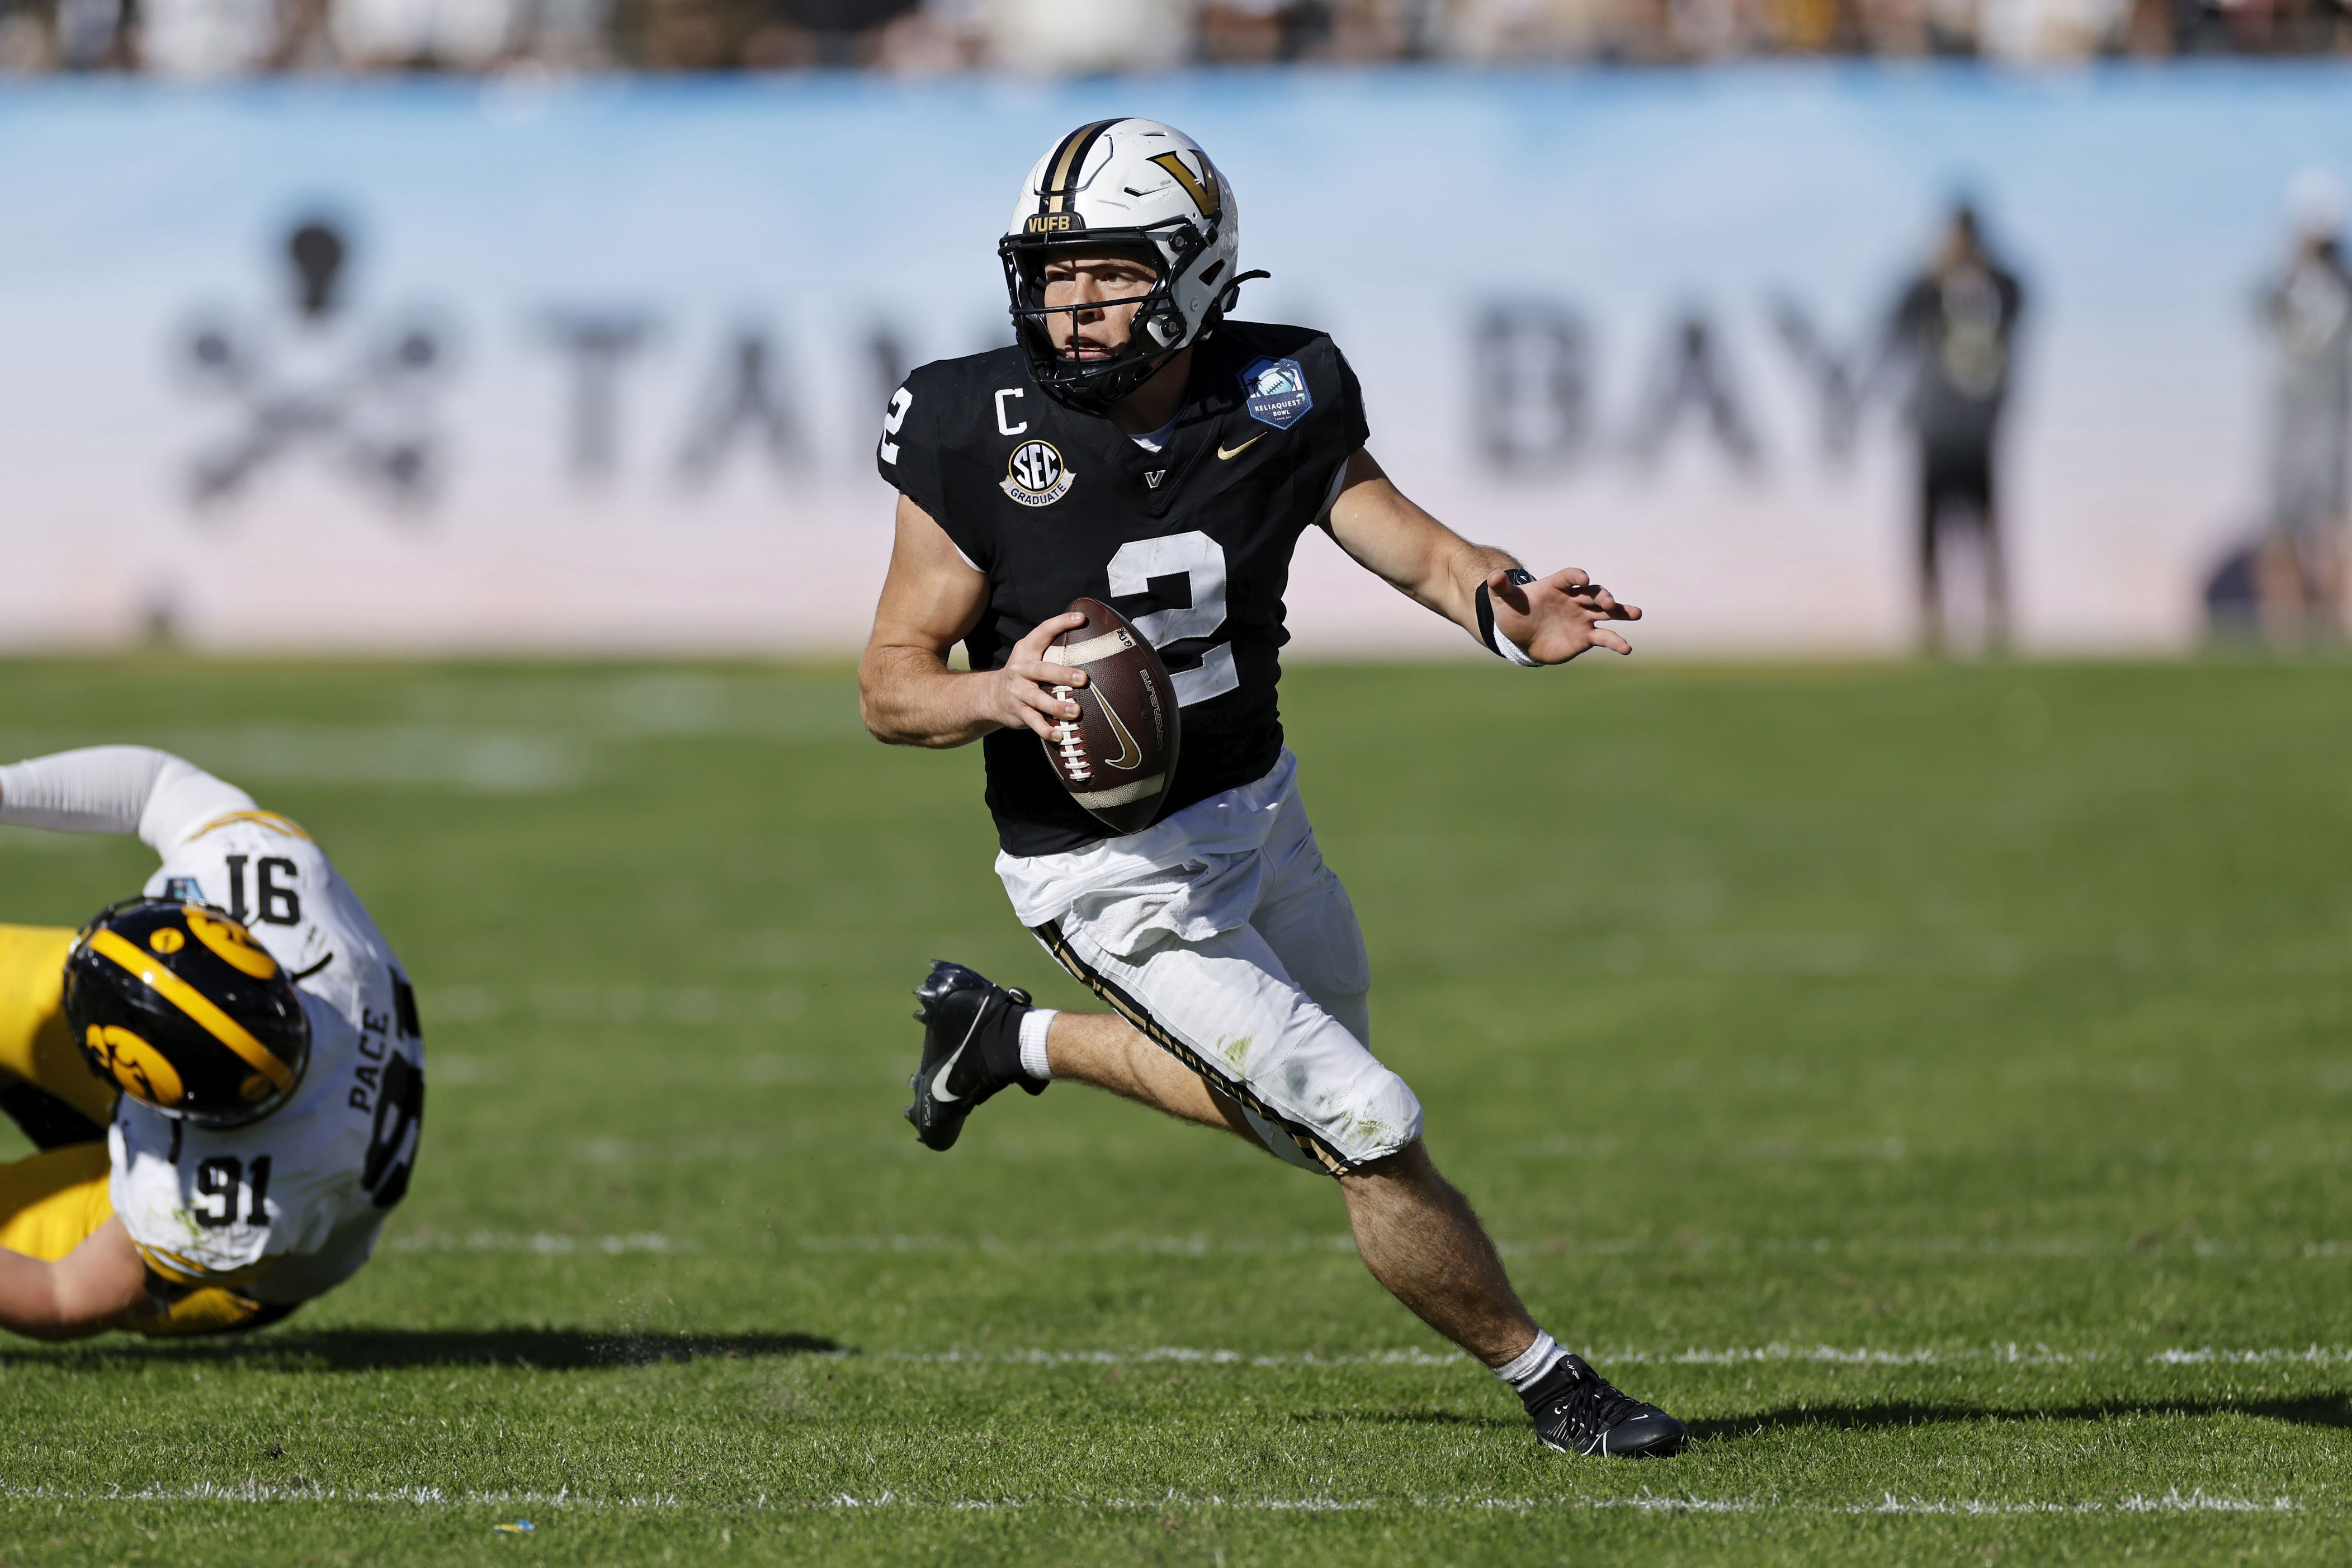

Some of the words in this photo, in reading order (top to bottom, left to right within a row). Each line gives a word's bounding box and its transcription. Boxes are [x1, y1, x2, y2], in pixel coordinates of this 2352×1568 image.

[1028, 216, 1070, 233] VUFB
[995, 388, 1027, 436] C
[1255, 399, 1301, 412] RELIAQUEST
[1473, 302, 1882, 478] BAY
[881, 387, 913, 465] 2
[1013, 444, 1058, 489] SEC
[1144, 470, 1166, 489] V
[1010, 483, 1066, 505] GRADUATE
[1107, 530, 1240, 709] 2
[1140, 669, 1159, 707] ELITE
[348, 1008, 389, 1115] PACE
[195, 1155, 272, 1227] 91
